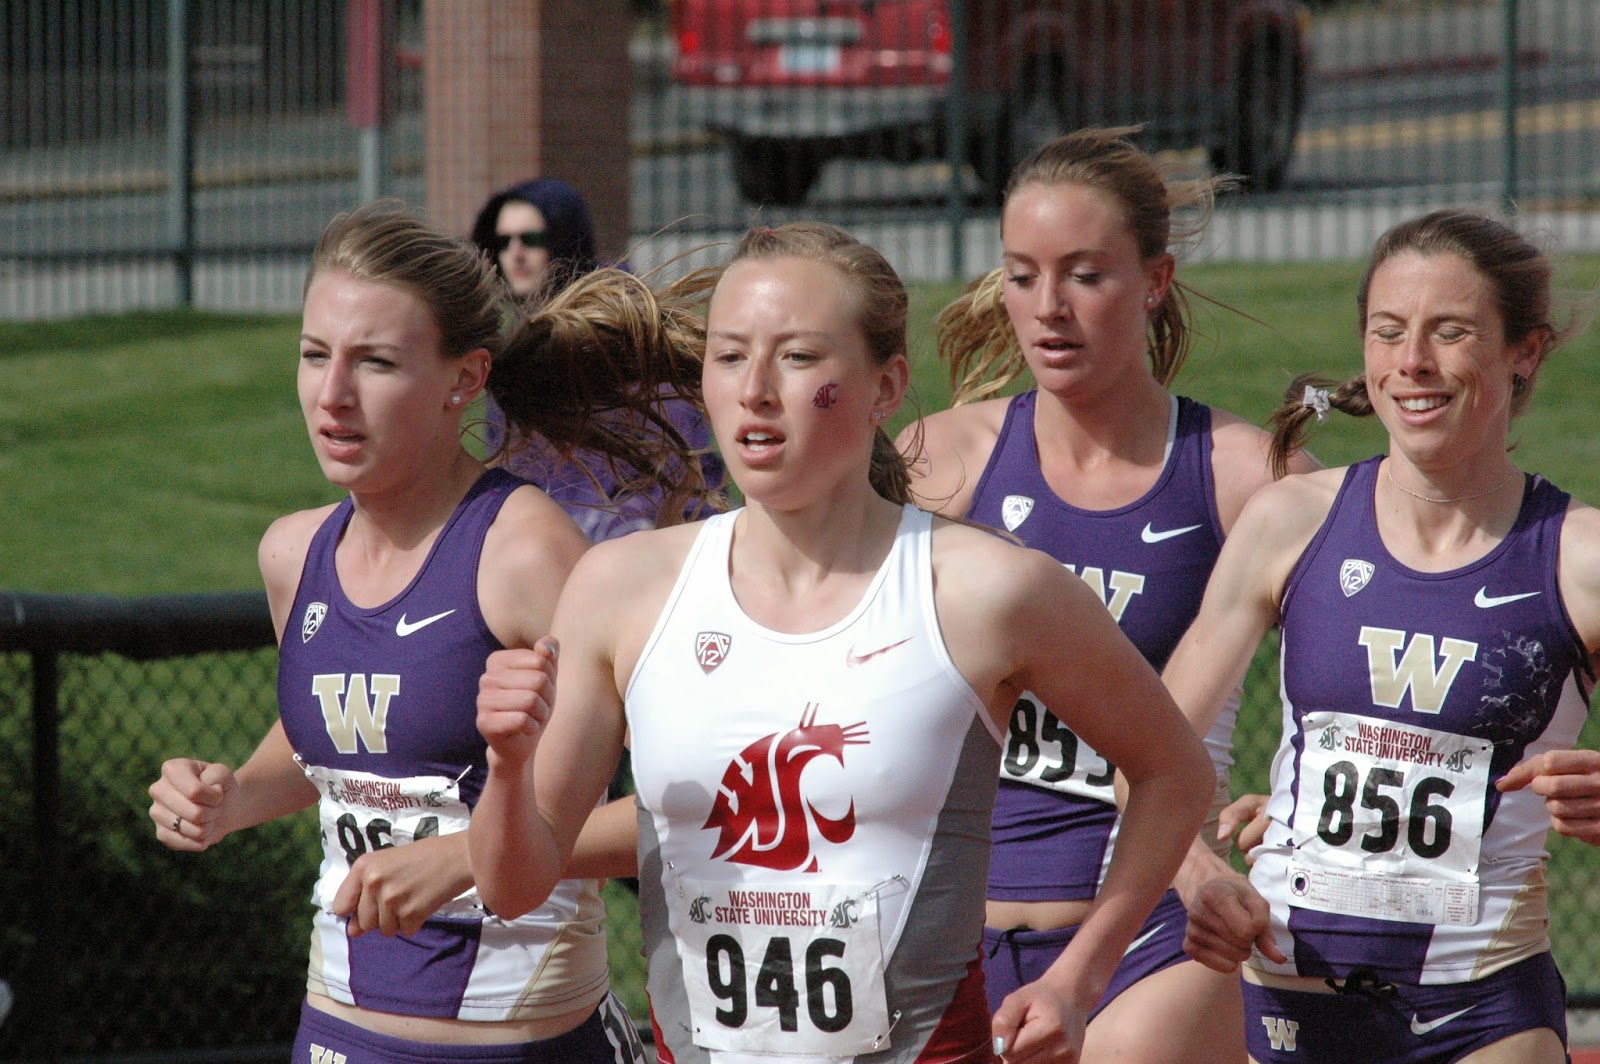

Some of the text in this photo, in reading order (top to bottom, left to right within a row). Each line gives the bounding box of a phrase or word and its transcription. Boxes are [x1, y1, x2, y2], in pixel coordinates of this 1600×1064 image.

[1342, 561, 1374, 585] PAC
[1344, 576, 1362, 590] 12
[304, 619, 317, 635] 12
[306, 604, 328, 627] PAC
[697, 633, 730, 659] PAC
[701, 649, 720, 666] 12
[1358, 626, 1479, 715] W
[312, 673, 401, 754] W
[1357, 722, 1432, 750] WASHINGTON
[1344, 735, 1445, 767] STATE UNIVERSITY
[340, 790, 364, 806] STATE
[342, 778, 401, 797] WASHINGTON
[1316, 760, 1456, 859] 856
[728, 890, 811, 910] WASHINGTON
[715, 906, 828, 927] STATE UNIVERSITY
[1416, 909, 1434, 917] 0856
[705, 933, 854, 1033] 946
[1261, 1016, 1300, 1051] W
